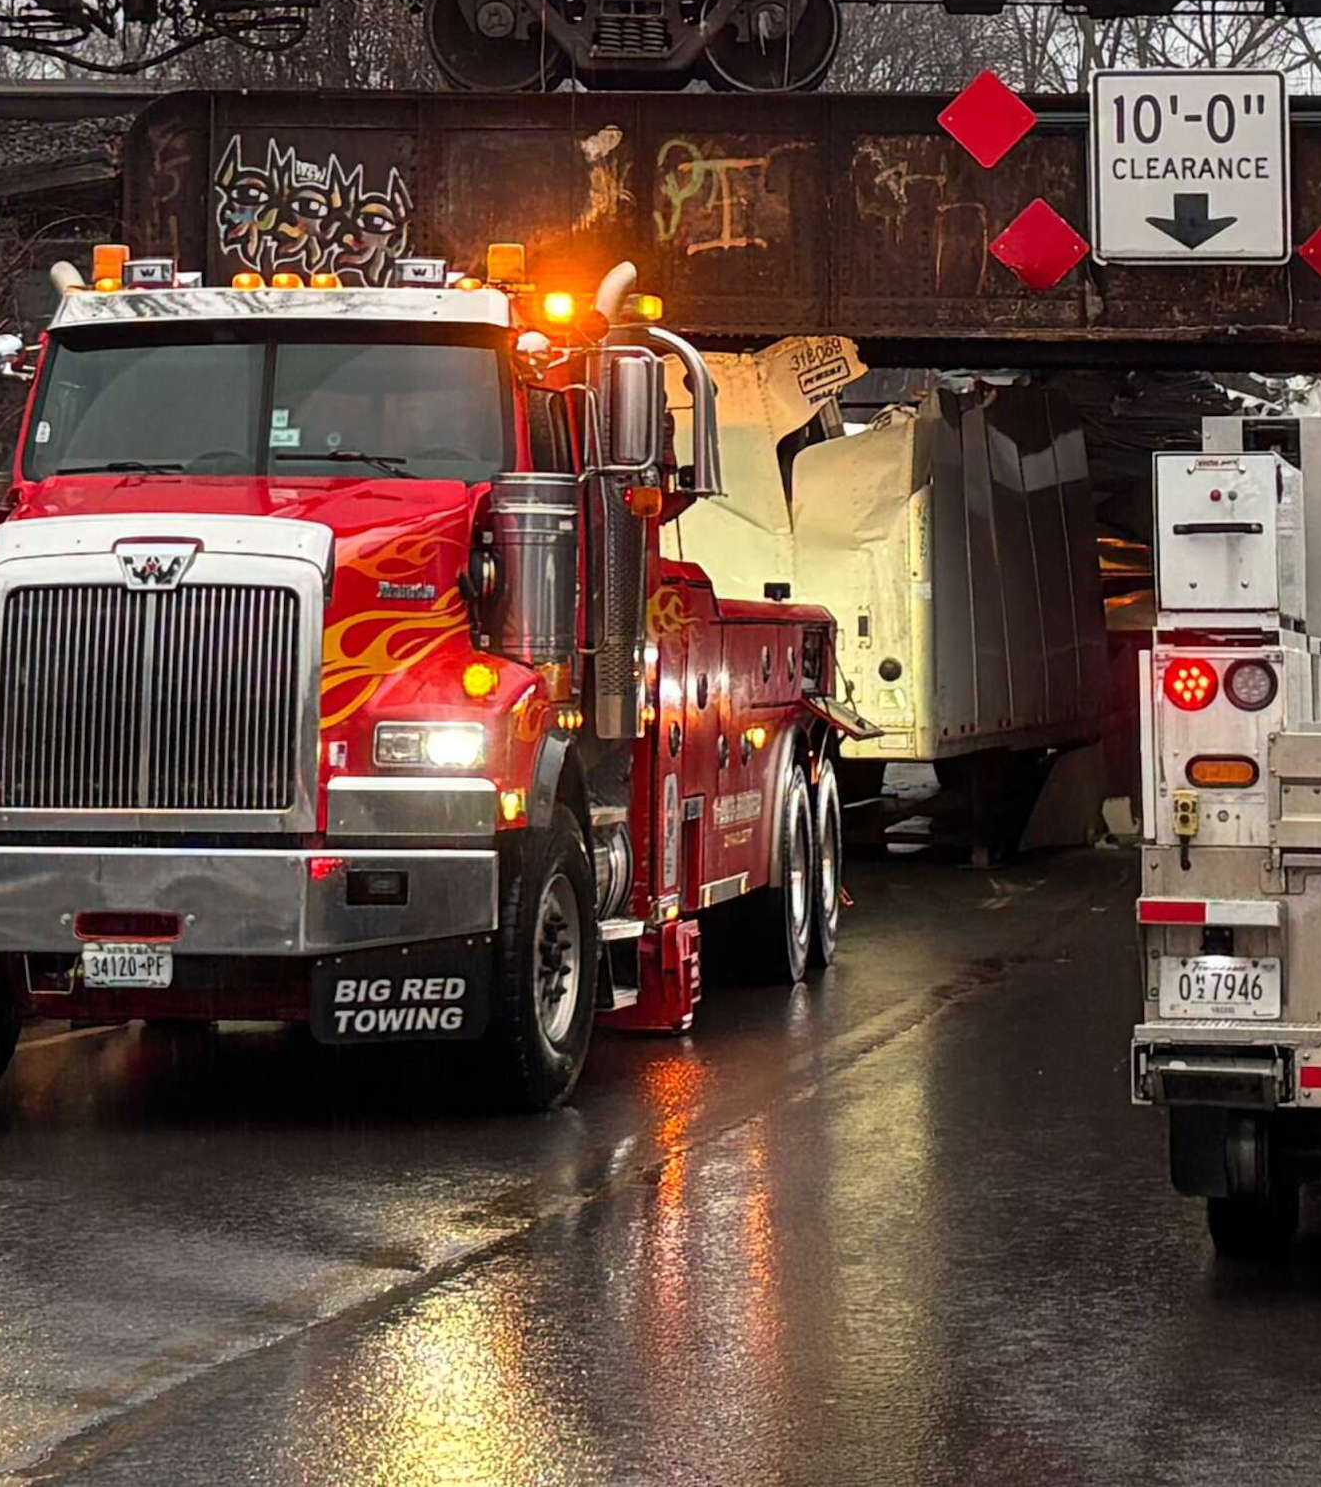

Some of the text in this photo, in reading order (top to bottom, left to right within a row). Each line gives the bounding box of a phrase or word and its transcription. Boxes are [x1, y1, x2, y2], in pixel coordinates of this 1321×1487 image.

[1113, 94, 1265, 144] 10'-0"
[1112, 156, 1271, 180] CLEARANCE
[334, 977, 466, 1003] BIG RED
[334, 1006, 464, 1034] TOWING
